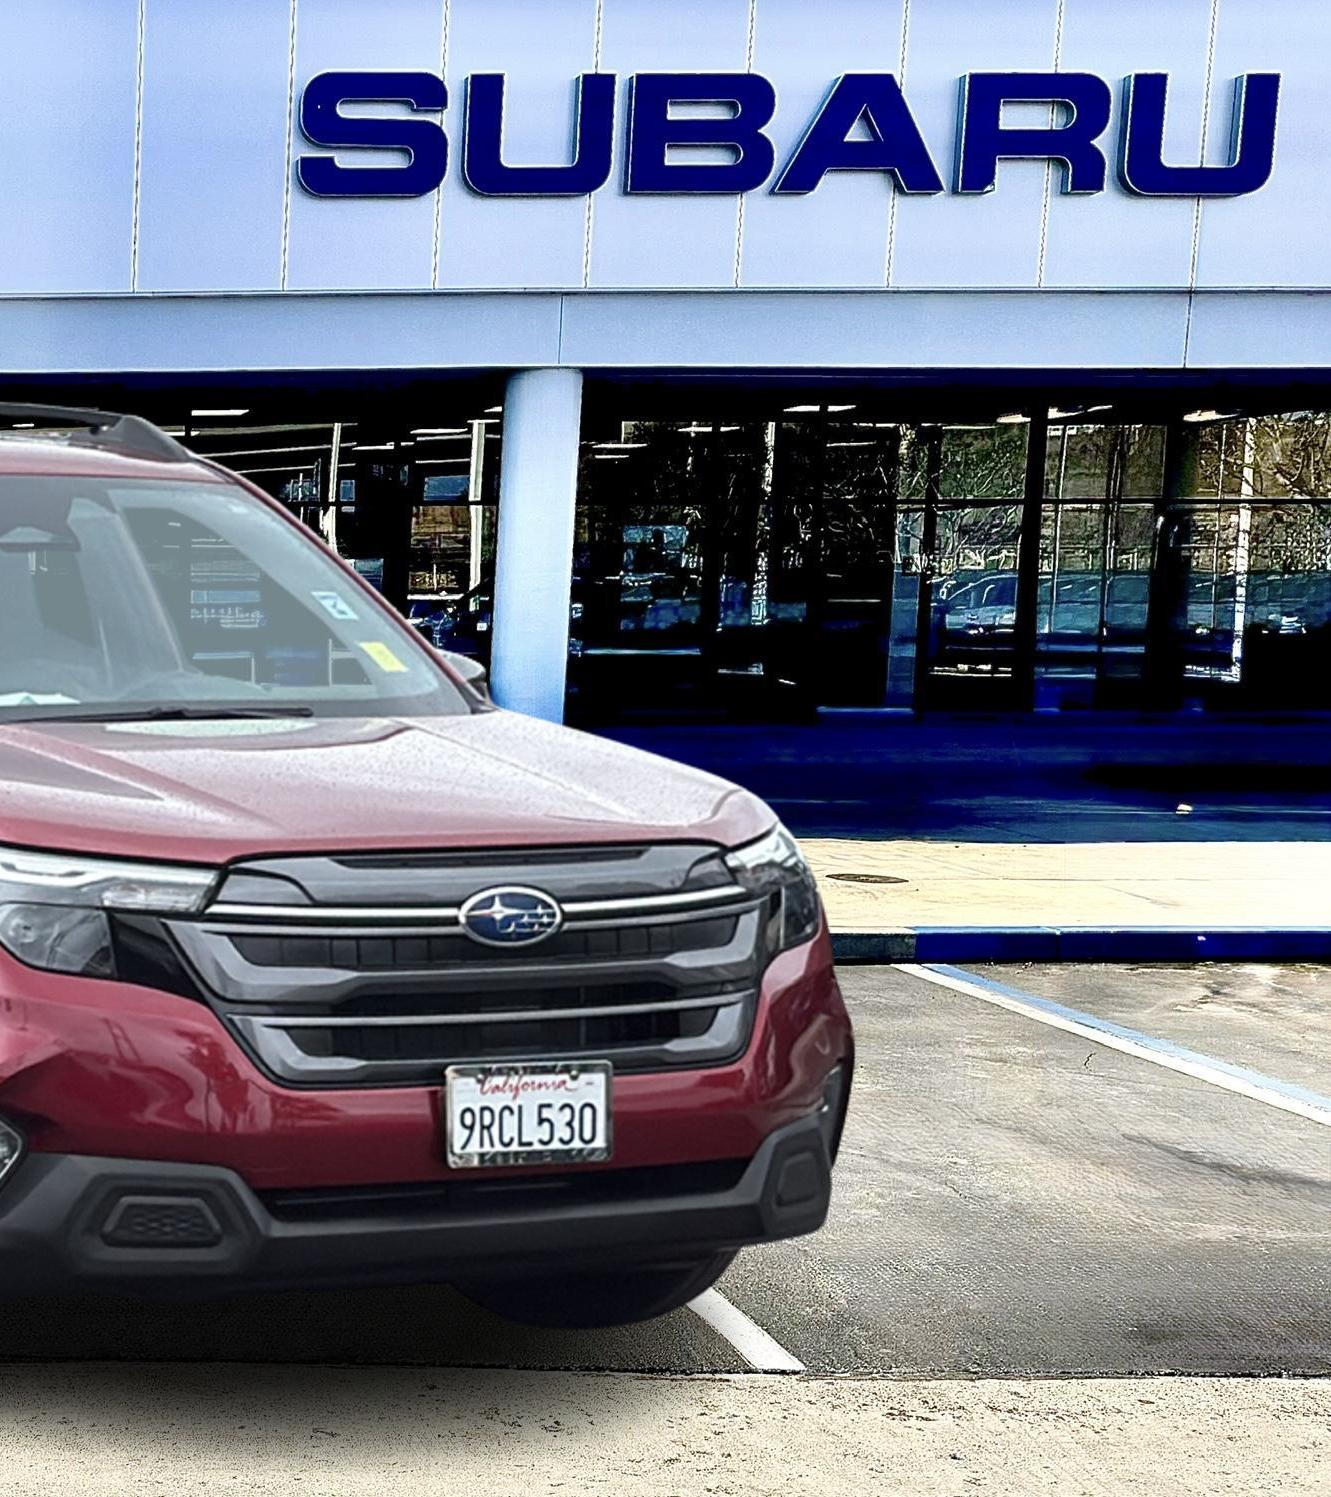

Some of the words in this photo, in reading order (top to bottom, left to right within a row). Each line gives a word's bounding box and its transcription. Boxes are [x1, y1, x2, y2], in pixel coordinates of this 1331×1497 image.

[297, 71, 1281, 197] SUBARU
[479, 1076, 578, 1100] California
[459, 1102, 598, 1151] 9RCL530
